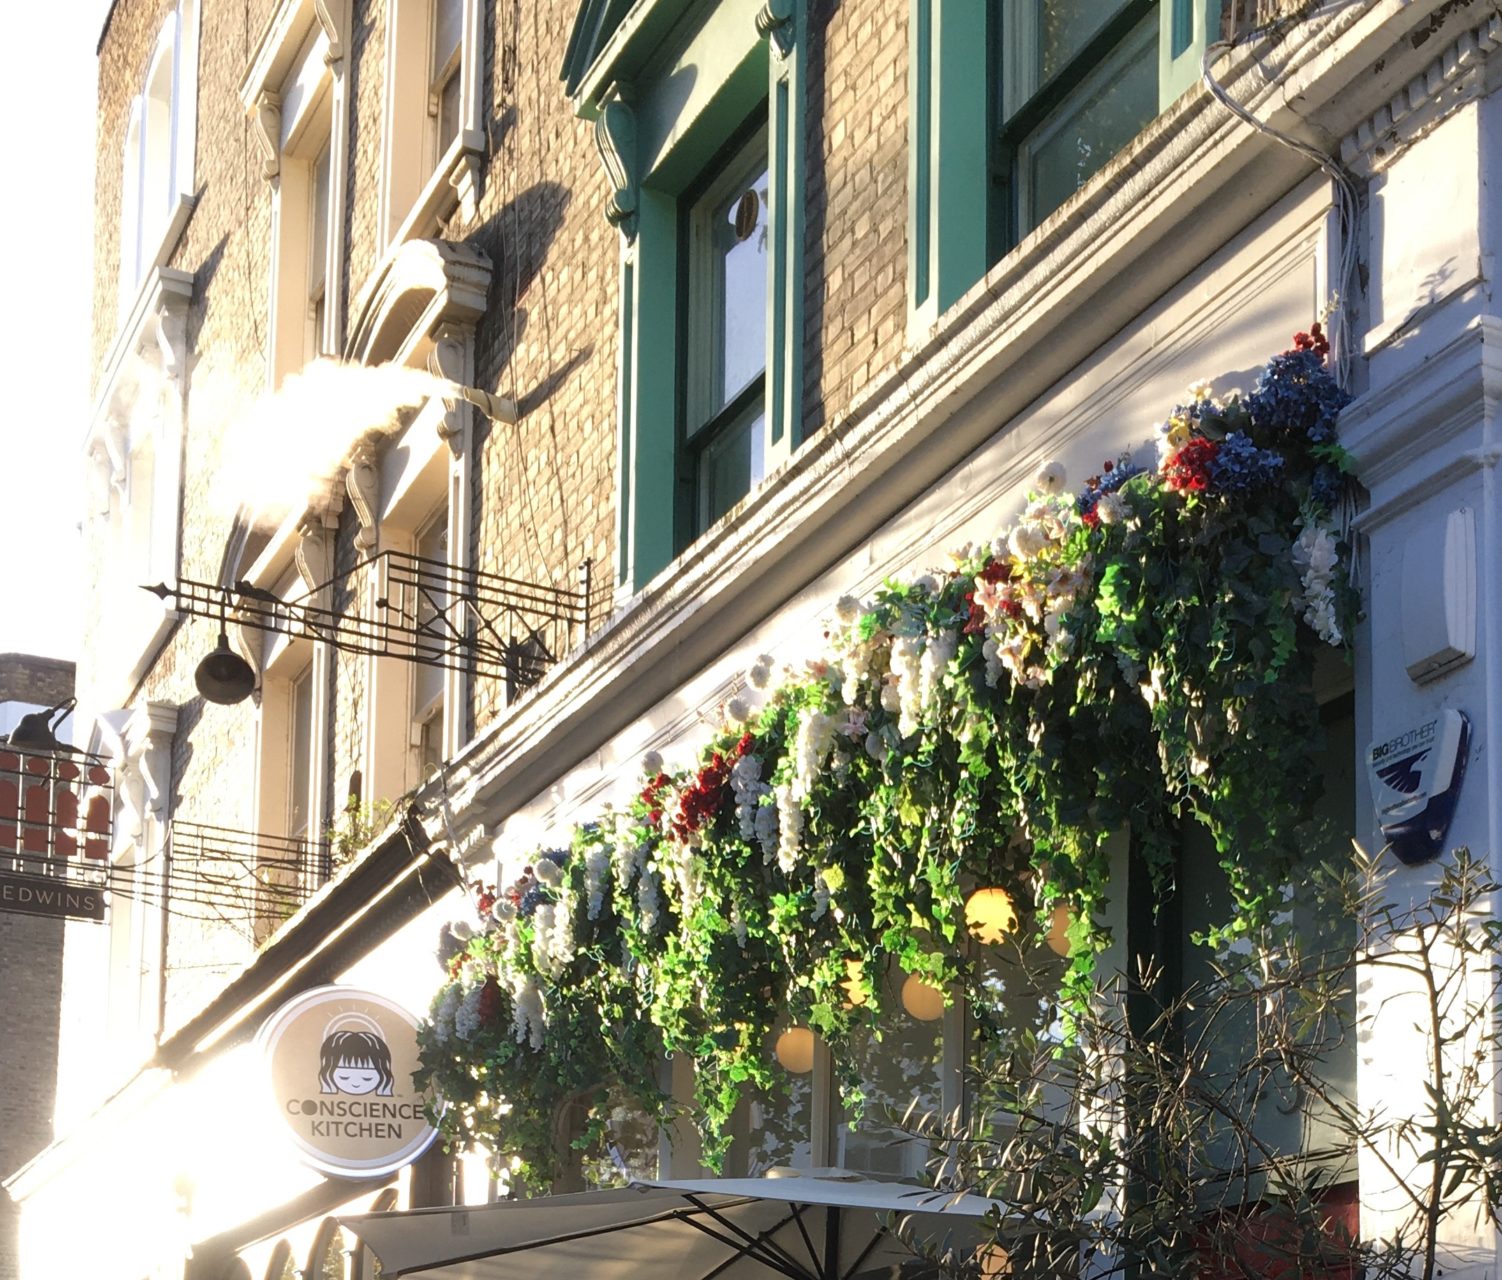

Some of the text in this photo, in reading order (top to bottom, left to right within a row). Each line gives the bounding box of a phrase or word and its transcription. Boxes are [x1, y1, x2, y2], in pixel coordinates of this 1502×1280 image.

[2, 885, 95, 911] EDWINS
[286, 1099, 424, 1120] CONSCIENCE
[311, 1121, 402, 1139] KITCHEN
